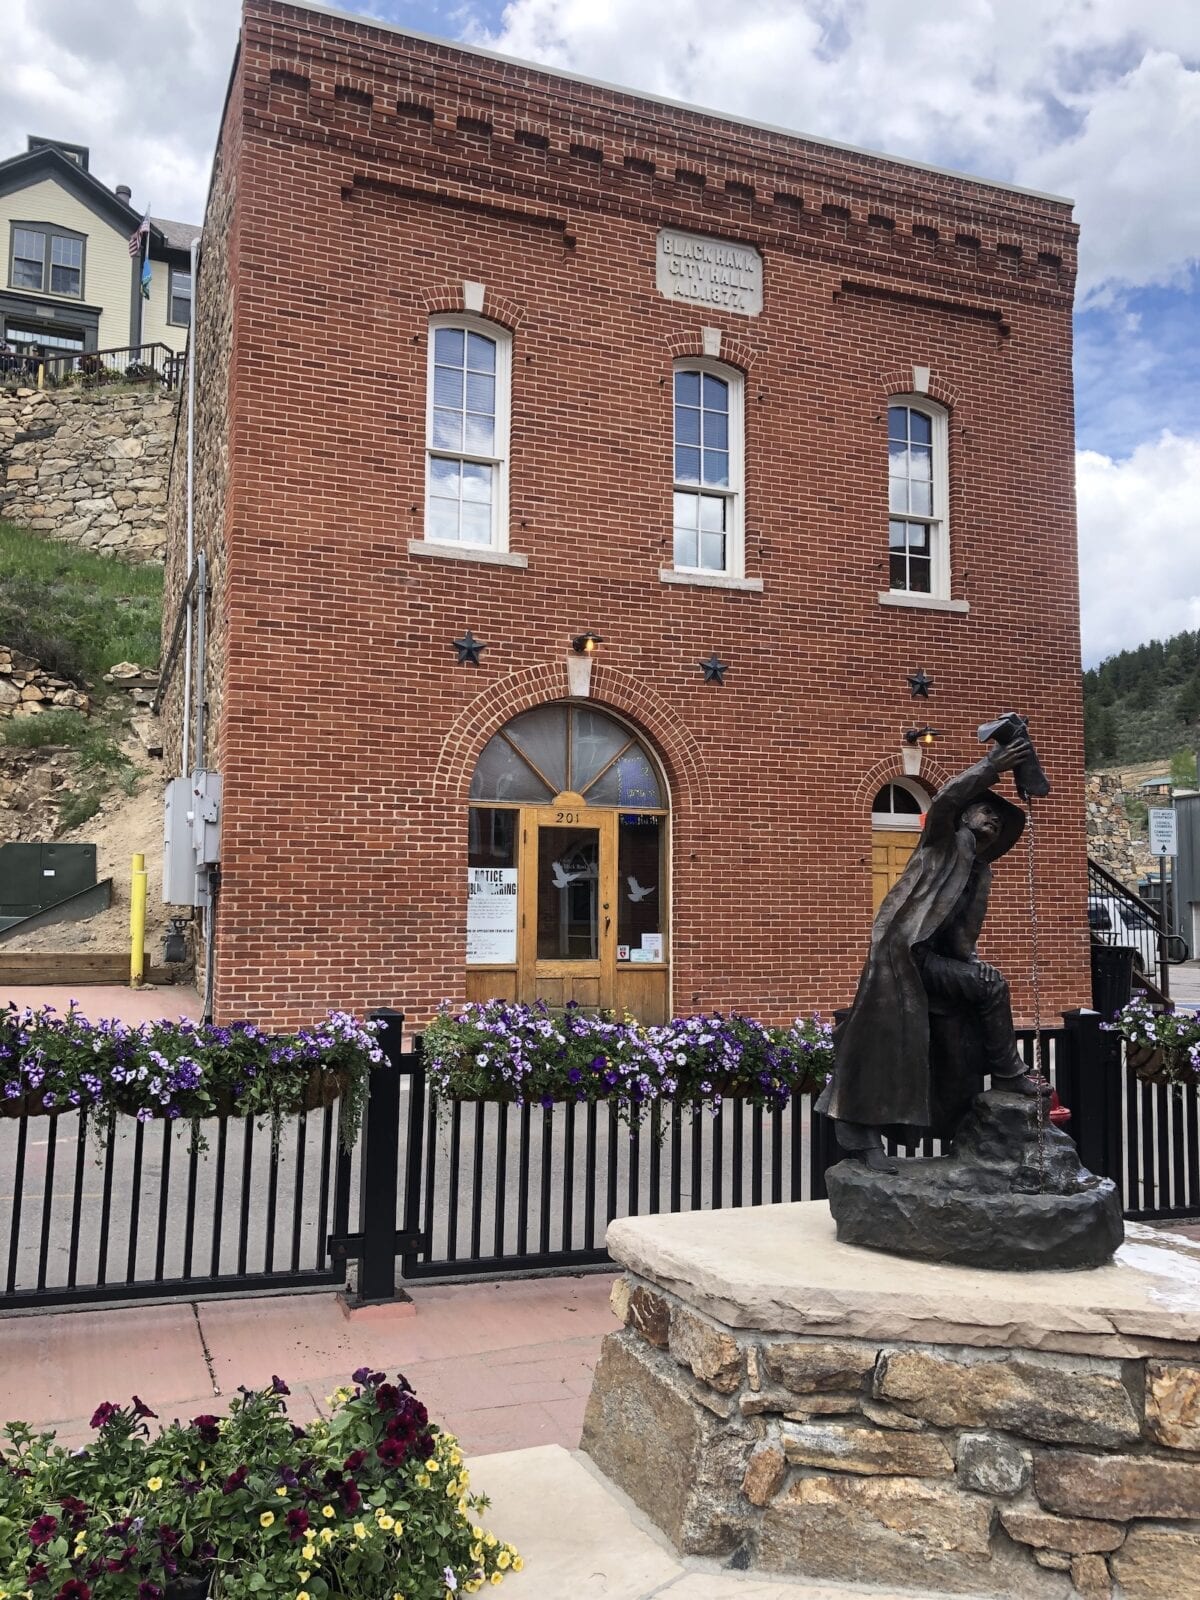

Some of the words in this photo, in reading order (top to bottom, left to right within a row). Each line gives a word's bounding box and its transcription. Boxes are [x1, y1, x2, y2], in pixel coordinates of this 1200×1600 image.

[663, 237, 711, 263] BLACK
[714, 247, 754, 273] HAWK
[669, 257, 705, 280] CITY
[555, 812, 579, 823] 201
[475, 870, 503, 882] NOTICE
[486, 883, 517, 895] RING
